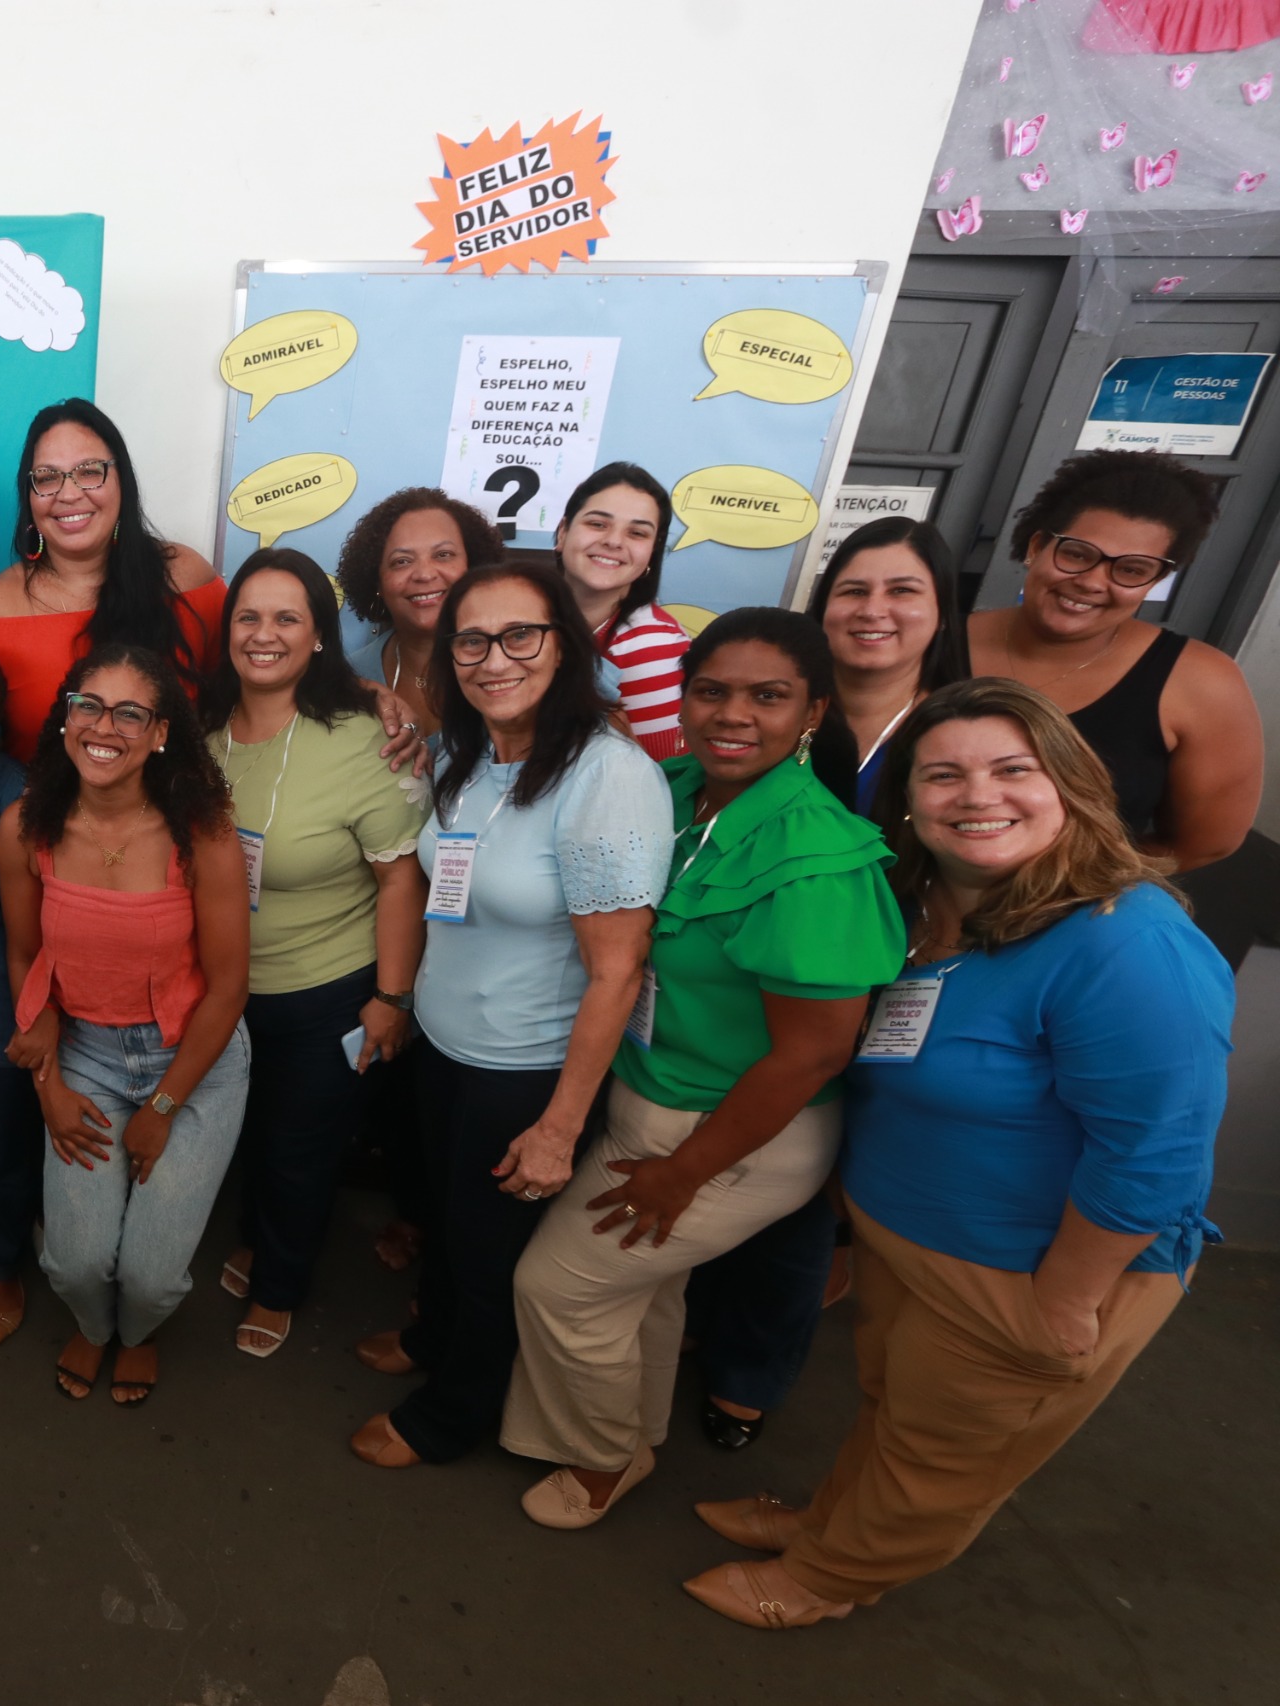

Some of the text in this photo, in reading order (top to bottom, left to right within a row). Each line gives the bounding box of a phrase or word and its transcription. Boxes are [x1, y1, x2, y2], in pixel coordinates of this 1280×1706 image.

[459, 146, 551, 202] FELIZ
[455, 175, 574, 235] DIA DO
[457, 201, 591, 257] SERVIDOR
[243, 337, 324, 368] ADMIRÁVEL
[739, 340, 814, 368] ESPECIAL
[499, 358, 573, 372] ESPELHO,
[480, 379, 587, 391] ESPELHO MEU
[1113, 379, 1129, 394] 11
[1173, 376, 1240, 388] GESTÃO DE
[1173, 391, 1227, 401] PESSOAS
[484, 401, 574, 412] QUEM FAZ A
[471, 420, 579, 435] DIFERENÇA NA
[482, 433, 563, 449] EDUCAÇÃO
[1119, 435, 1161, 444] CAMPOS
[254, 474, 322, 506] DEDICADO
[710, 494, 781, 513] INCRÍVEL
[439, 858, 469, 868] SERVIDOR
[441, 867, 465, 877] PÚBLICO
[885, 999, 928, 1009] SERVIDOR
[885, 1008, 922, 1019] PÚBLICO
